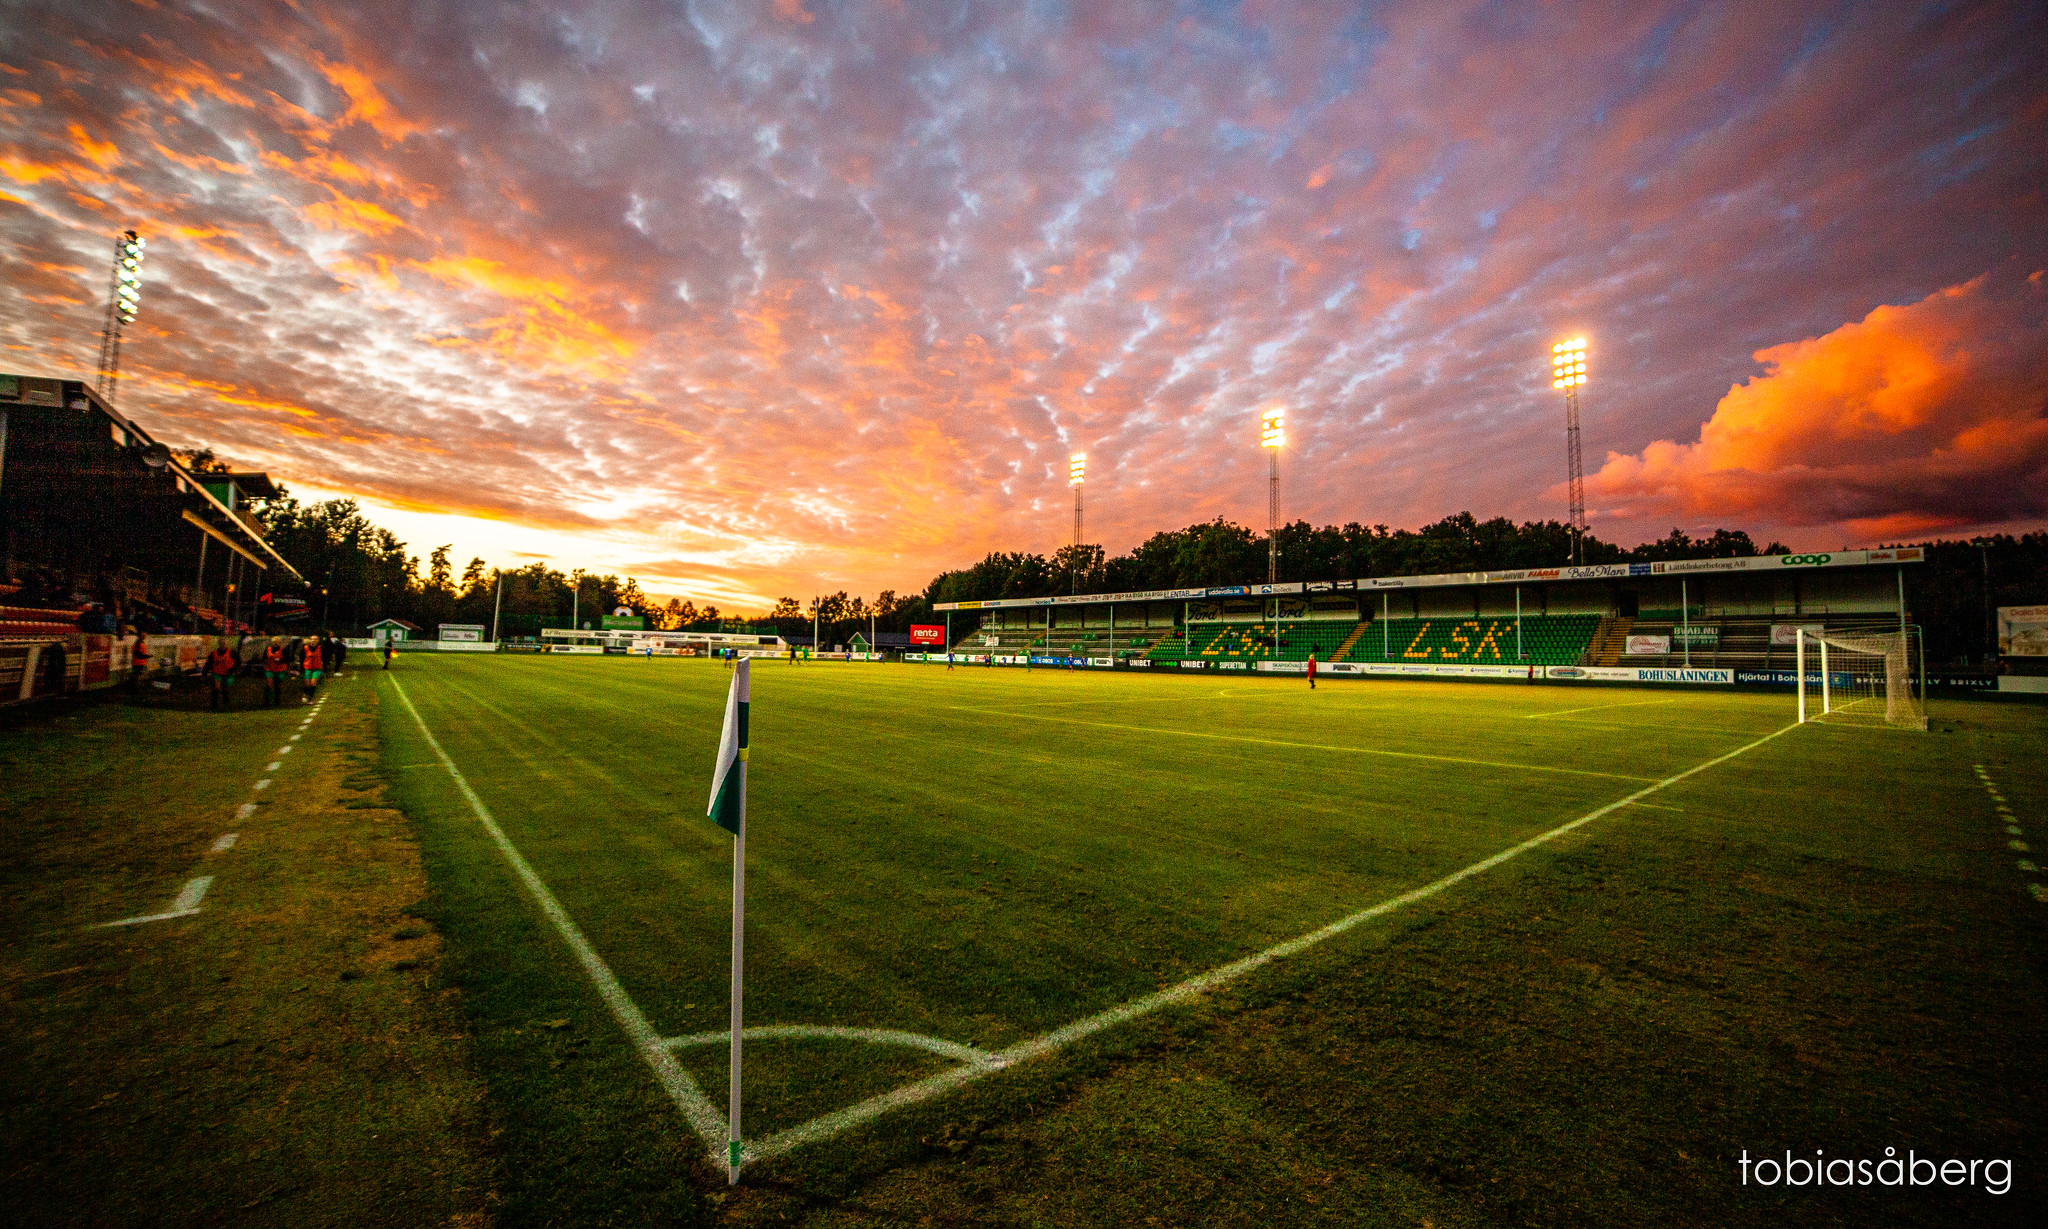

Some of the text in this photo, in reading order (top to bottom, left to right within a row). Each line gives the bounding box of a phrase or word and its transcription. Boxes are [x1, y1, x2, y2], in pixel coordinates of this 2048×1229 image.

[1781, 554, 1831, 566] coop
[1568, 567, 1594, 578] Bella
[1596, 566, 1626, 577] Mare
[1208, 588, 1240, 596] uddevalla.se
[1187, 603, 1220, 620] Ford
[1266, 601, 1306, 619] Ford
[913, 629, 938, 637] renta
[1638, 669, 1728, 682] BOHUSLÄNINGEN
[1738, 673, 1769, 682] Hjärtat
